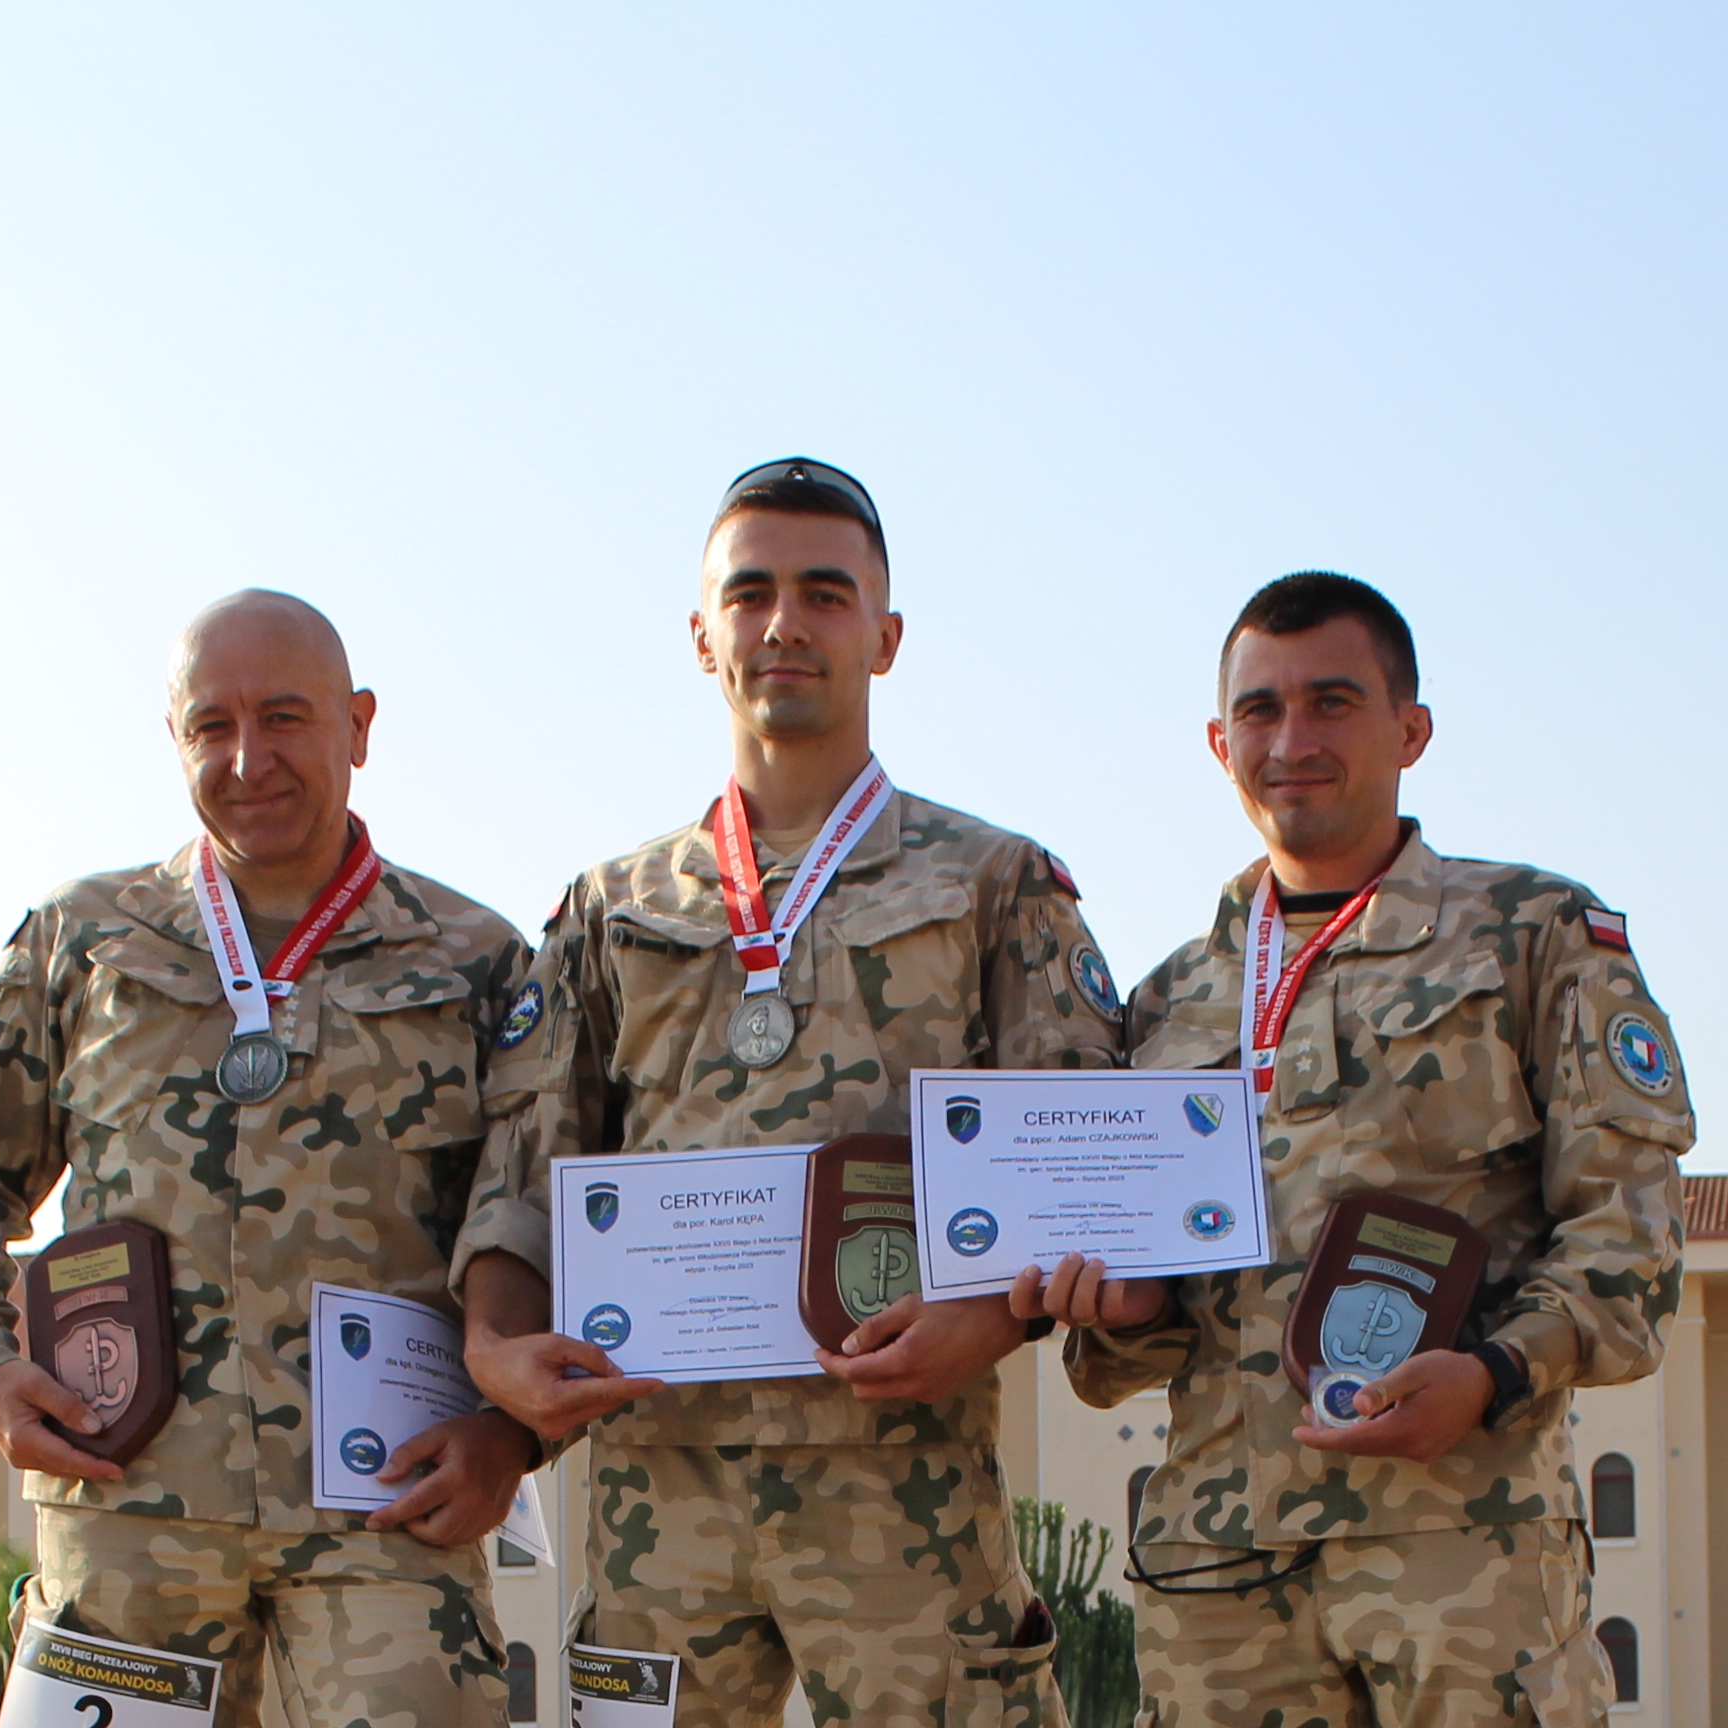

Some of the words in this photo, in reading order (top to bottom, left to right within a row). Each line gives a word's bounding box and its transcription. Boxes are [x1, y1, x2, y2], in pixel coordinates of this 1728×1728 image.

[1264, 972, 1294, 1045] MISTRZOSTWA
[1024, 1109, 1146, 1127] CERTYFIKAT
[1013, 1136, 1028, 1144] dla
[1031, 1136, 1054, 1145] ppor.
[1058, 1133, 1086, 1143] Adam
[1088, 1132, 1159, 1143] CZAJKOWSKI
[660, 1187, 777, 1211] CERTYFIKAT
[673, 1219, 687, 1230] dla
[689, 1218, 707, 1231] por.
[710, 1215, 734, 1227] Karol
[736, 1213, 765, 1226] KĘPA
[737, 1262, 754, 1270] 2023
[399, 1359, 412, 1370] kpt.
[50, 1642, 71, 1659] XXVII
[72, 1647, 92, 1662] BIEG
[92, 1651, 158, 1675] PRZEŁAJOWY
[46, 1654, 74, 1675] NÓŻ
[75, 1663, 175, 1696] KOMANDOSA
